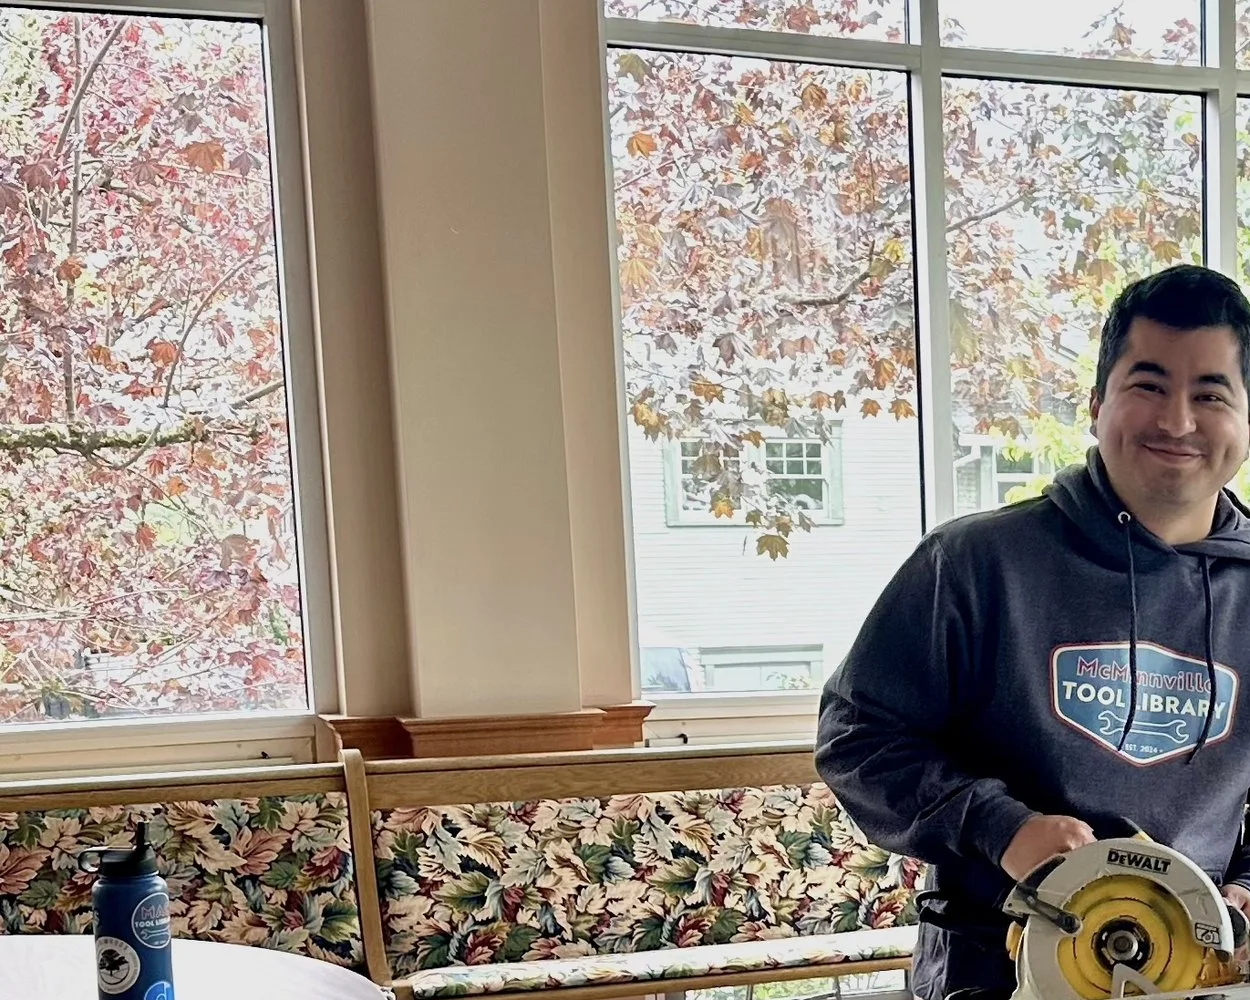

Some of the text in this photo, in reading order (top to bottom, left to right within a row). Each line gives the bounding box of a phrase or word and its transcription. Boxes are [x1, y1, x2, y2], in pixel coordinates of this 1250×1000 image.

[1077, 655, 1215, 694] McMnnvill
[1062, 681, 1226, 720] TOOL IBRARY
